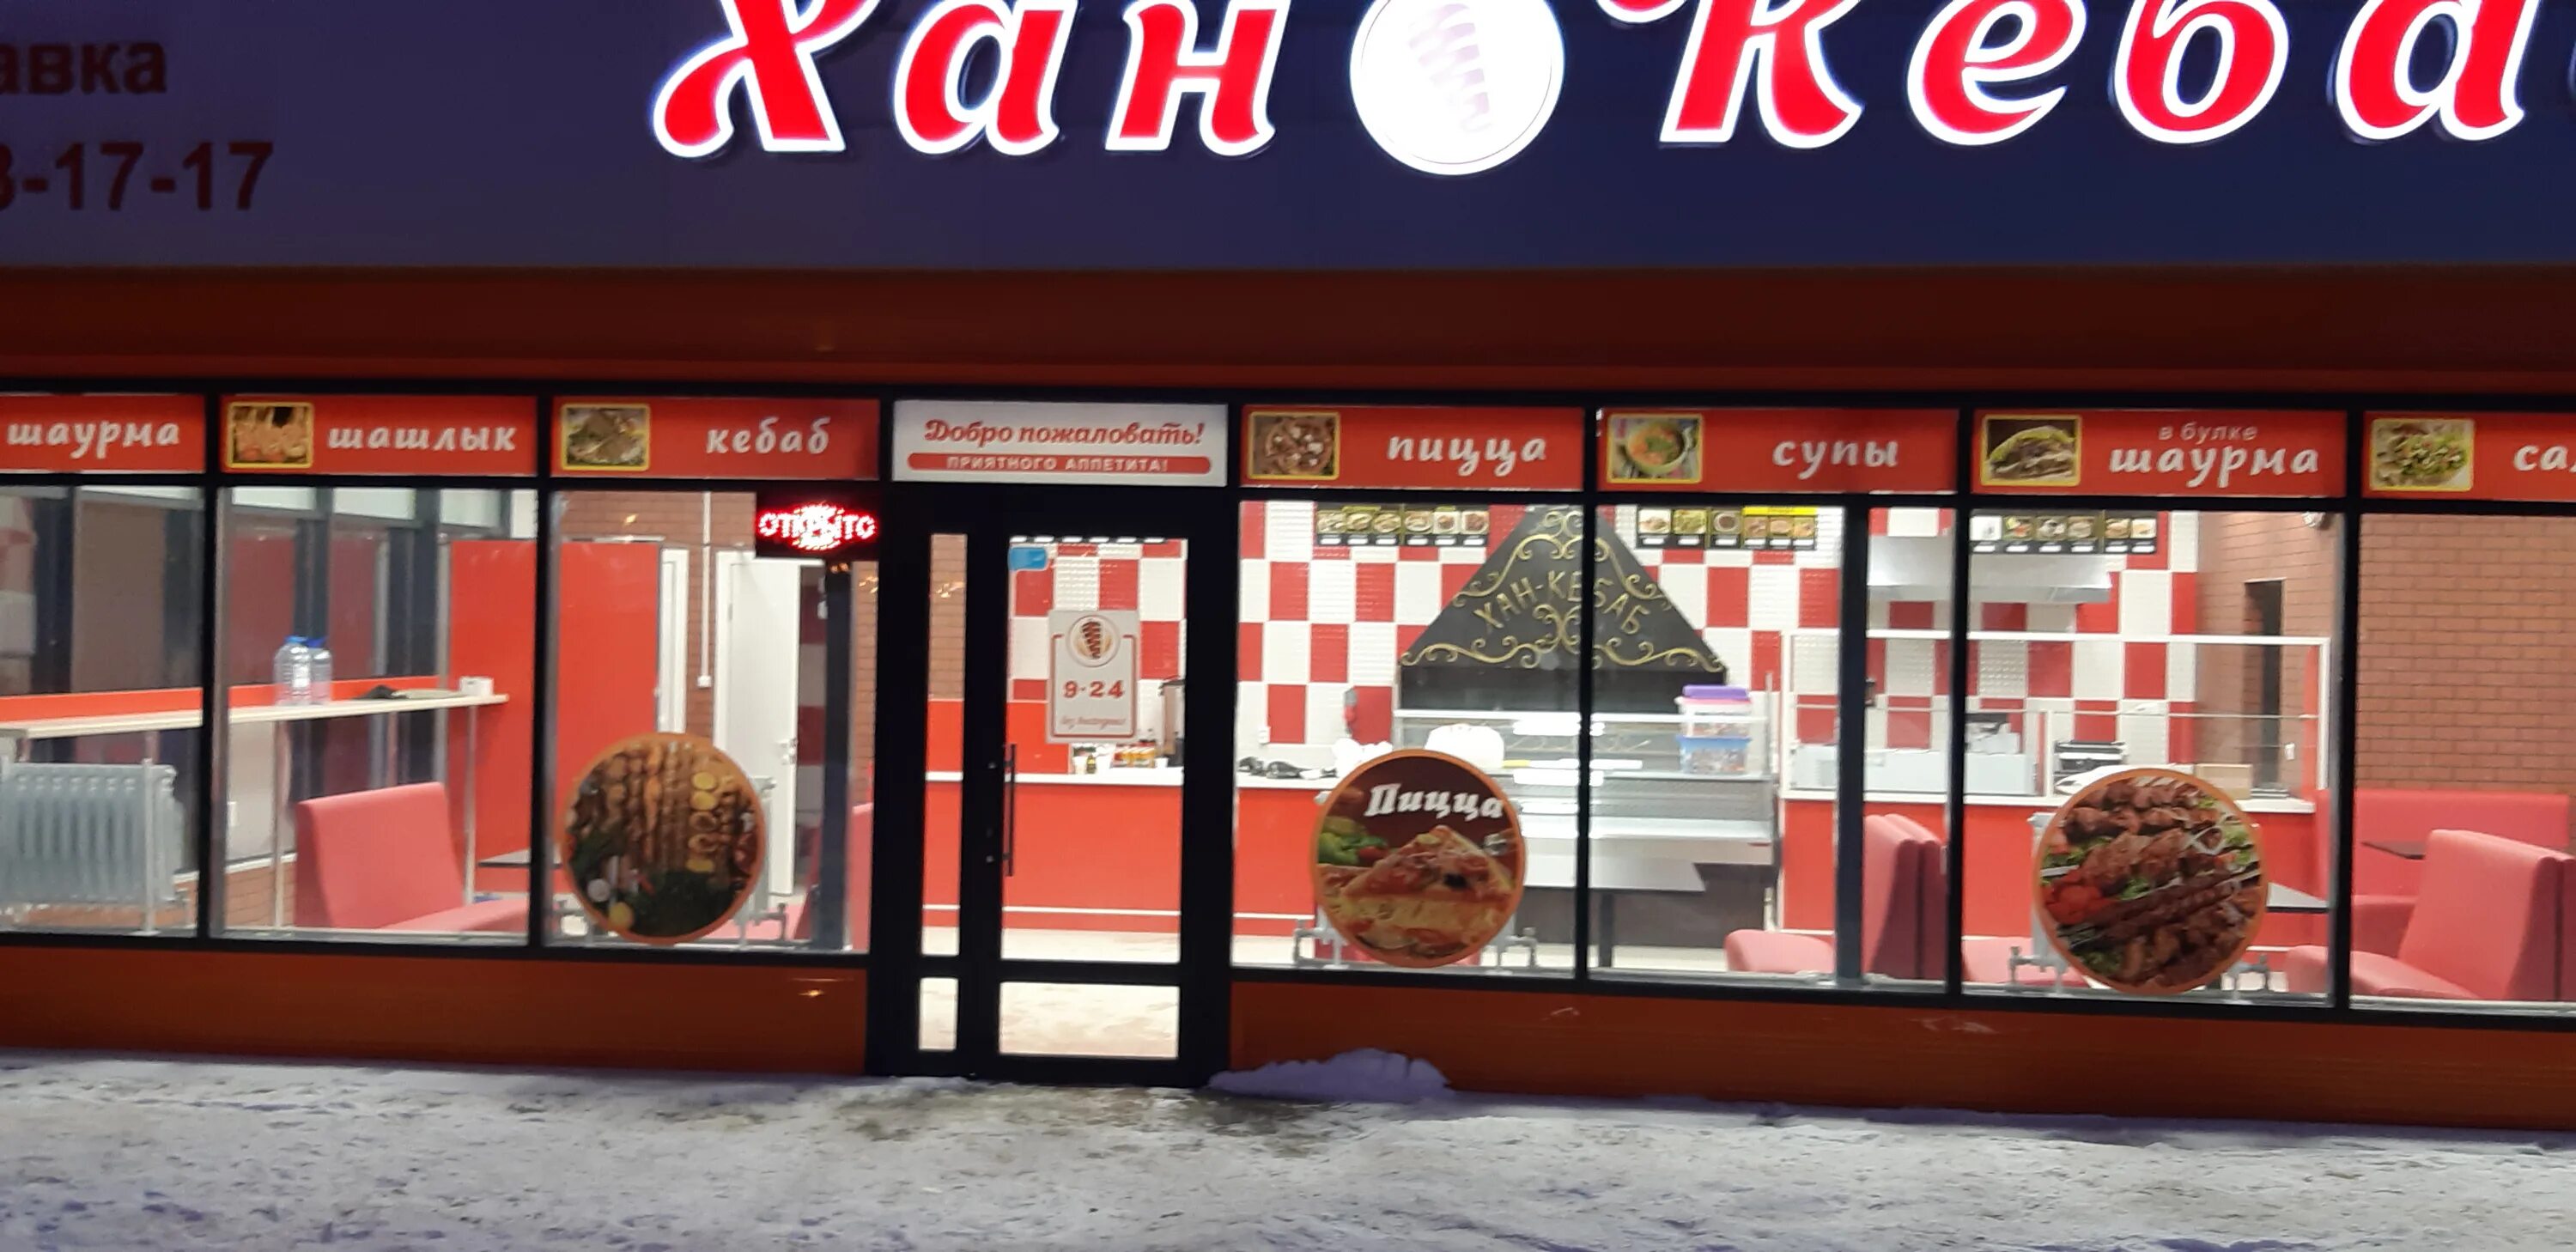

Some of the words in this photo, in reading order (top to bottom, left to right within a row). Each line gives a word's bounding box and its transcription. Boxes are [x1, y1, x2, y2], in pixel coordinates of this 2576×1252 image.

[653, 0, 1277, 156] Хан
[1595, 0, 2576, 149] Кеба
[7, 420, 180, 459] шаурма
[327, 423, 517, 453] шашлык
[706, 416, 831, 454] кебаб
[924, 419, 1012, 447] Добро
[1018, 421, 1206, 447] пожаловать!
[2158, 427, 2172, 441] в
[2181, 422, 2259, 442] булке
[946, 454, 1058, 471] ПРИЯТНОГО
[1064, 456, 1169, 473] АППЕТИТА!
[1387, 432, 1548, 477] пицца
[1773, 435, 1900, 481] супы
[2109, 446, 2320, 489] шаурма
[2512, 444, 2576, 474] са
[1364, 783, 1504, 822] Пицца
